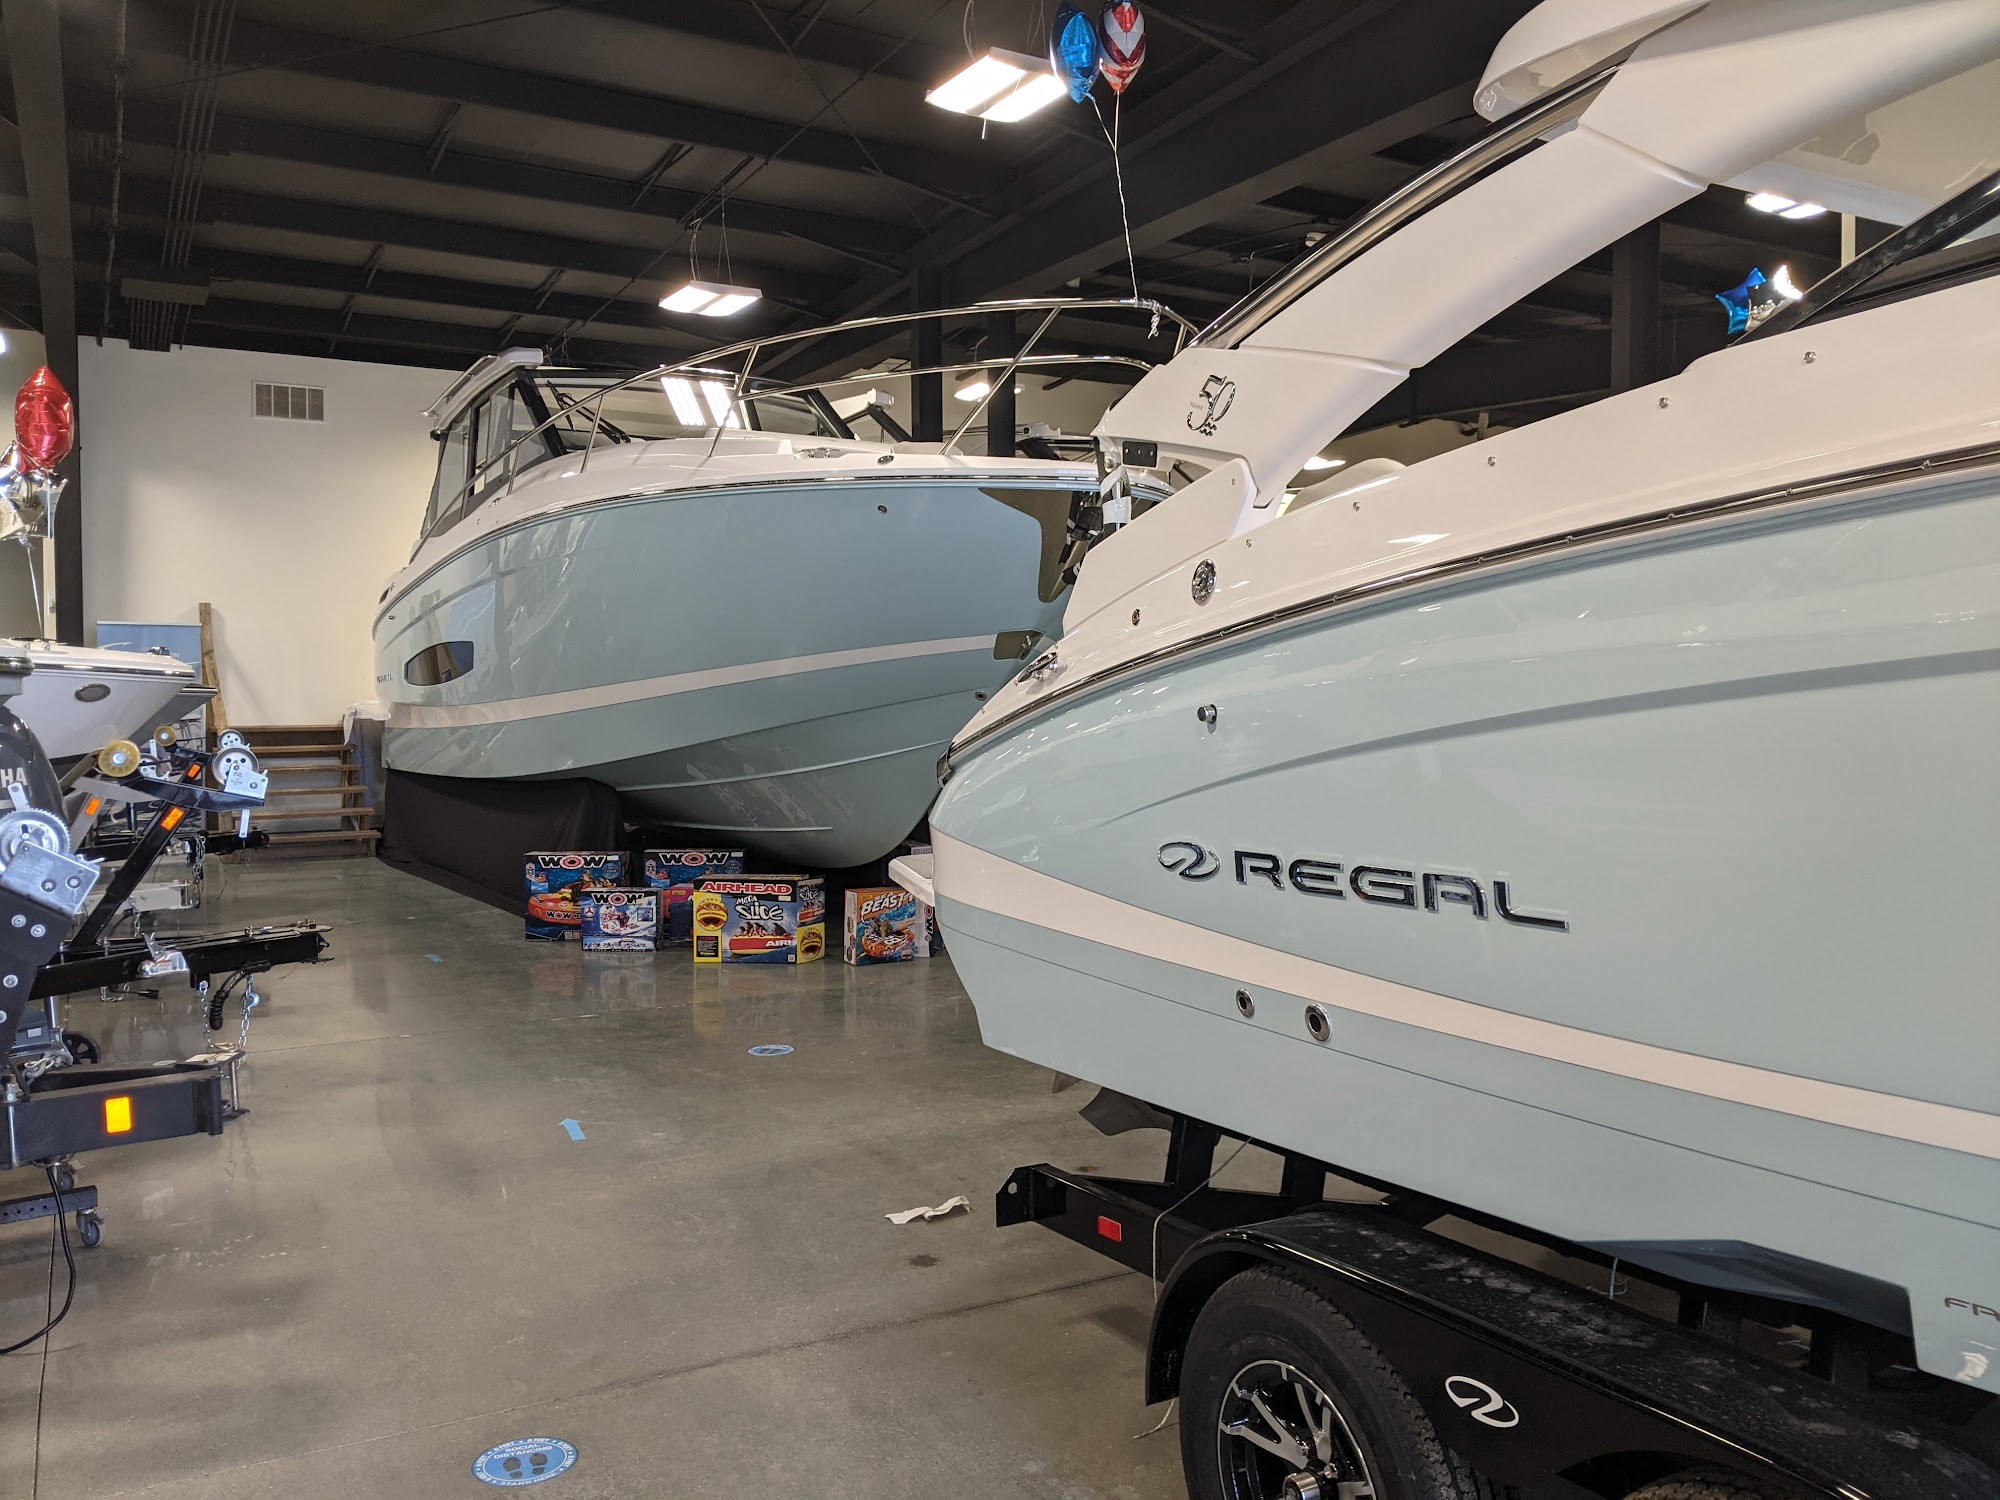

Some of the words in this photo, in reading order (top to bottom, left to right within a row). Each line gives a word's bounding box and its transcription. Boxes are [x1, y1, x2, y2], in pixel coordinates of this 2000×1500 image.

[538, 855, 607, 869] WOW
[658, 852, 729, 866] WOW
[699, 881, 793, 895] AIRHEAD
[1234, 849, 1570, 933] REGAL
[591, 892, 645, 906] WOW
[545, 910, 573, 919] WOW
[732, 901, 784, 920] SLICE
[493, 1445, 553, 1459] DISTANCING
[504, 1443, 541, 1452] SOCIAL
[534, 1472, 557, 1482] HERE
